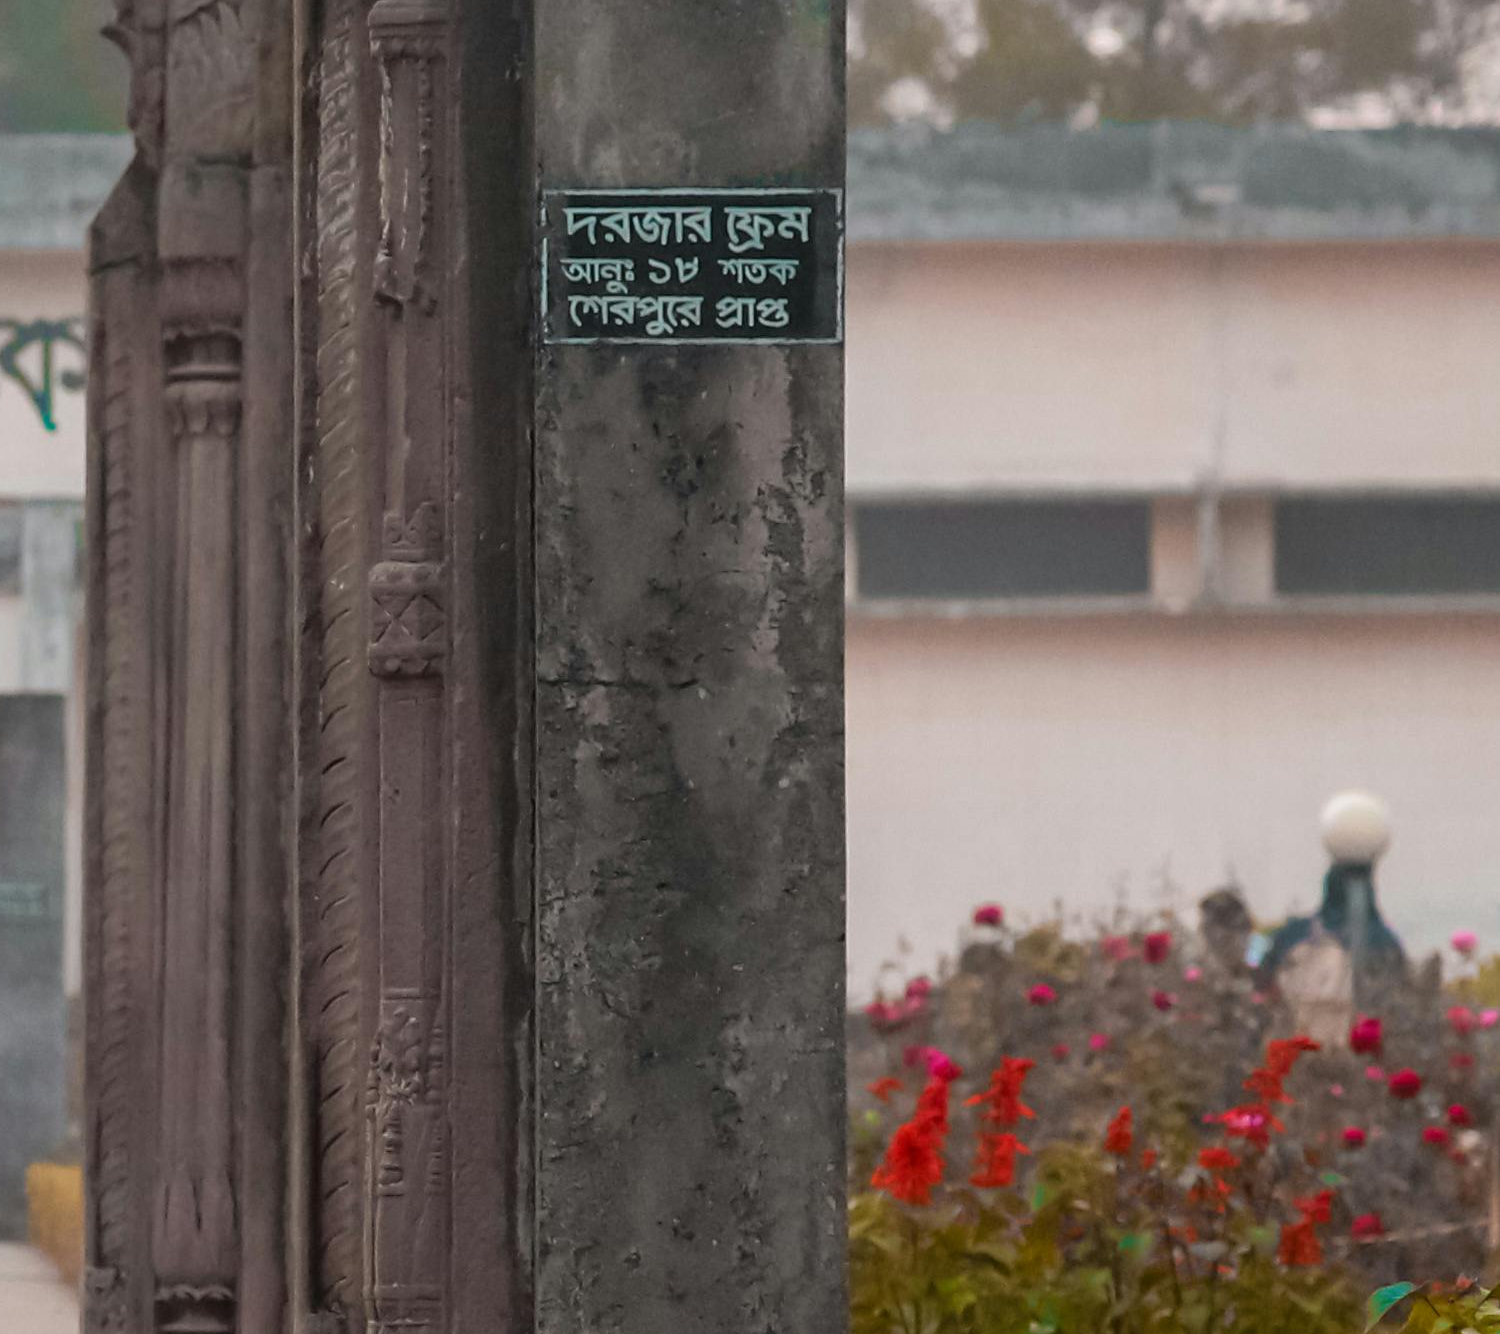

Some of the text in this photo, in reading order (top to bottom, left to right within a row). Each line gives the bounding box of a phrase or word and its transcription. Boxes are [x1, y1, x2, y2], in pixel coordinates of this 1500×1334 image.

[562, 206, 812, 253] দরজার ফ্রেম
[648, 256, 699, 284] ১৮
[717, 259, 800, 286] শতক
[567, 295, 790, 337] শেরপুরে প্রাপ্ত
